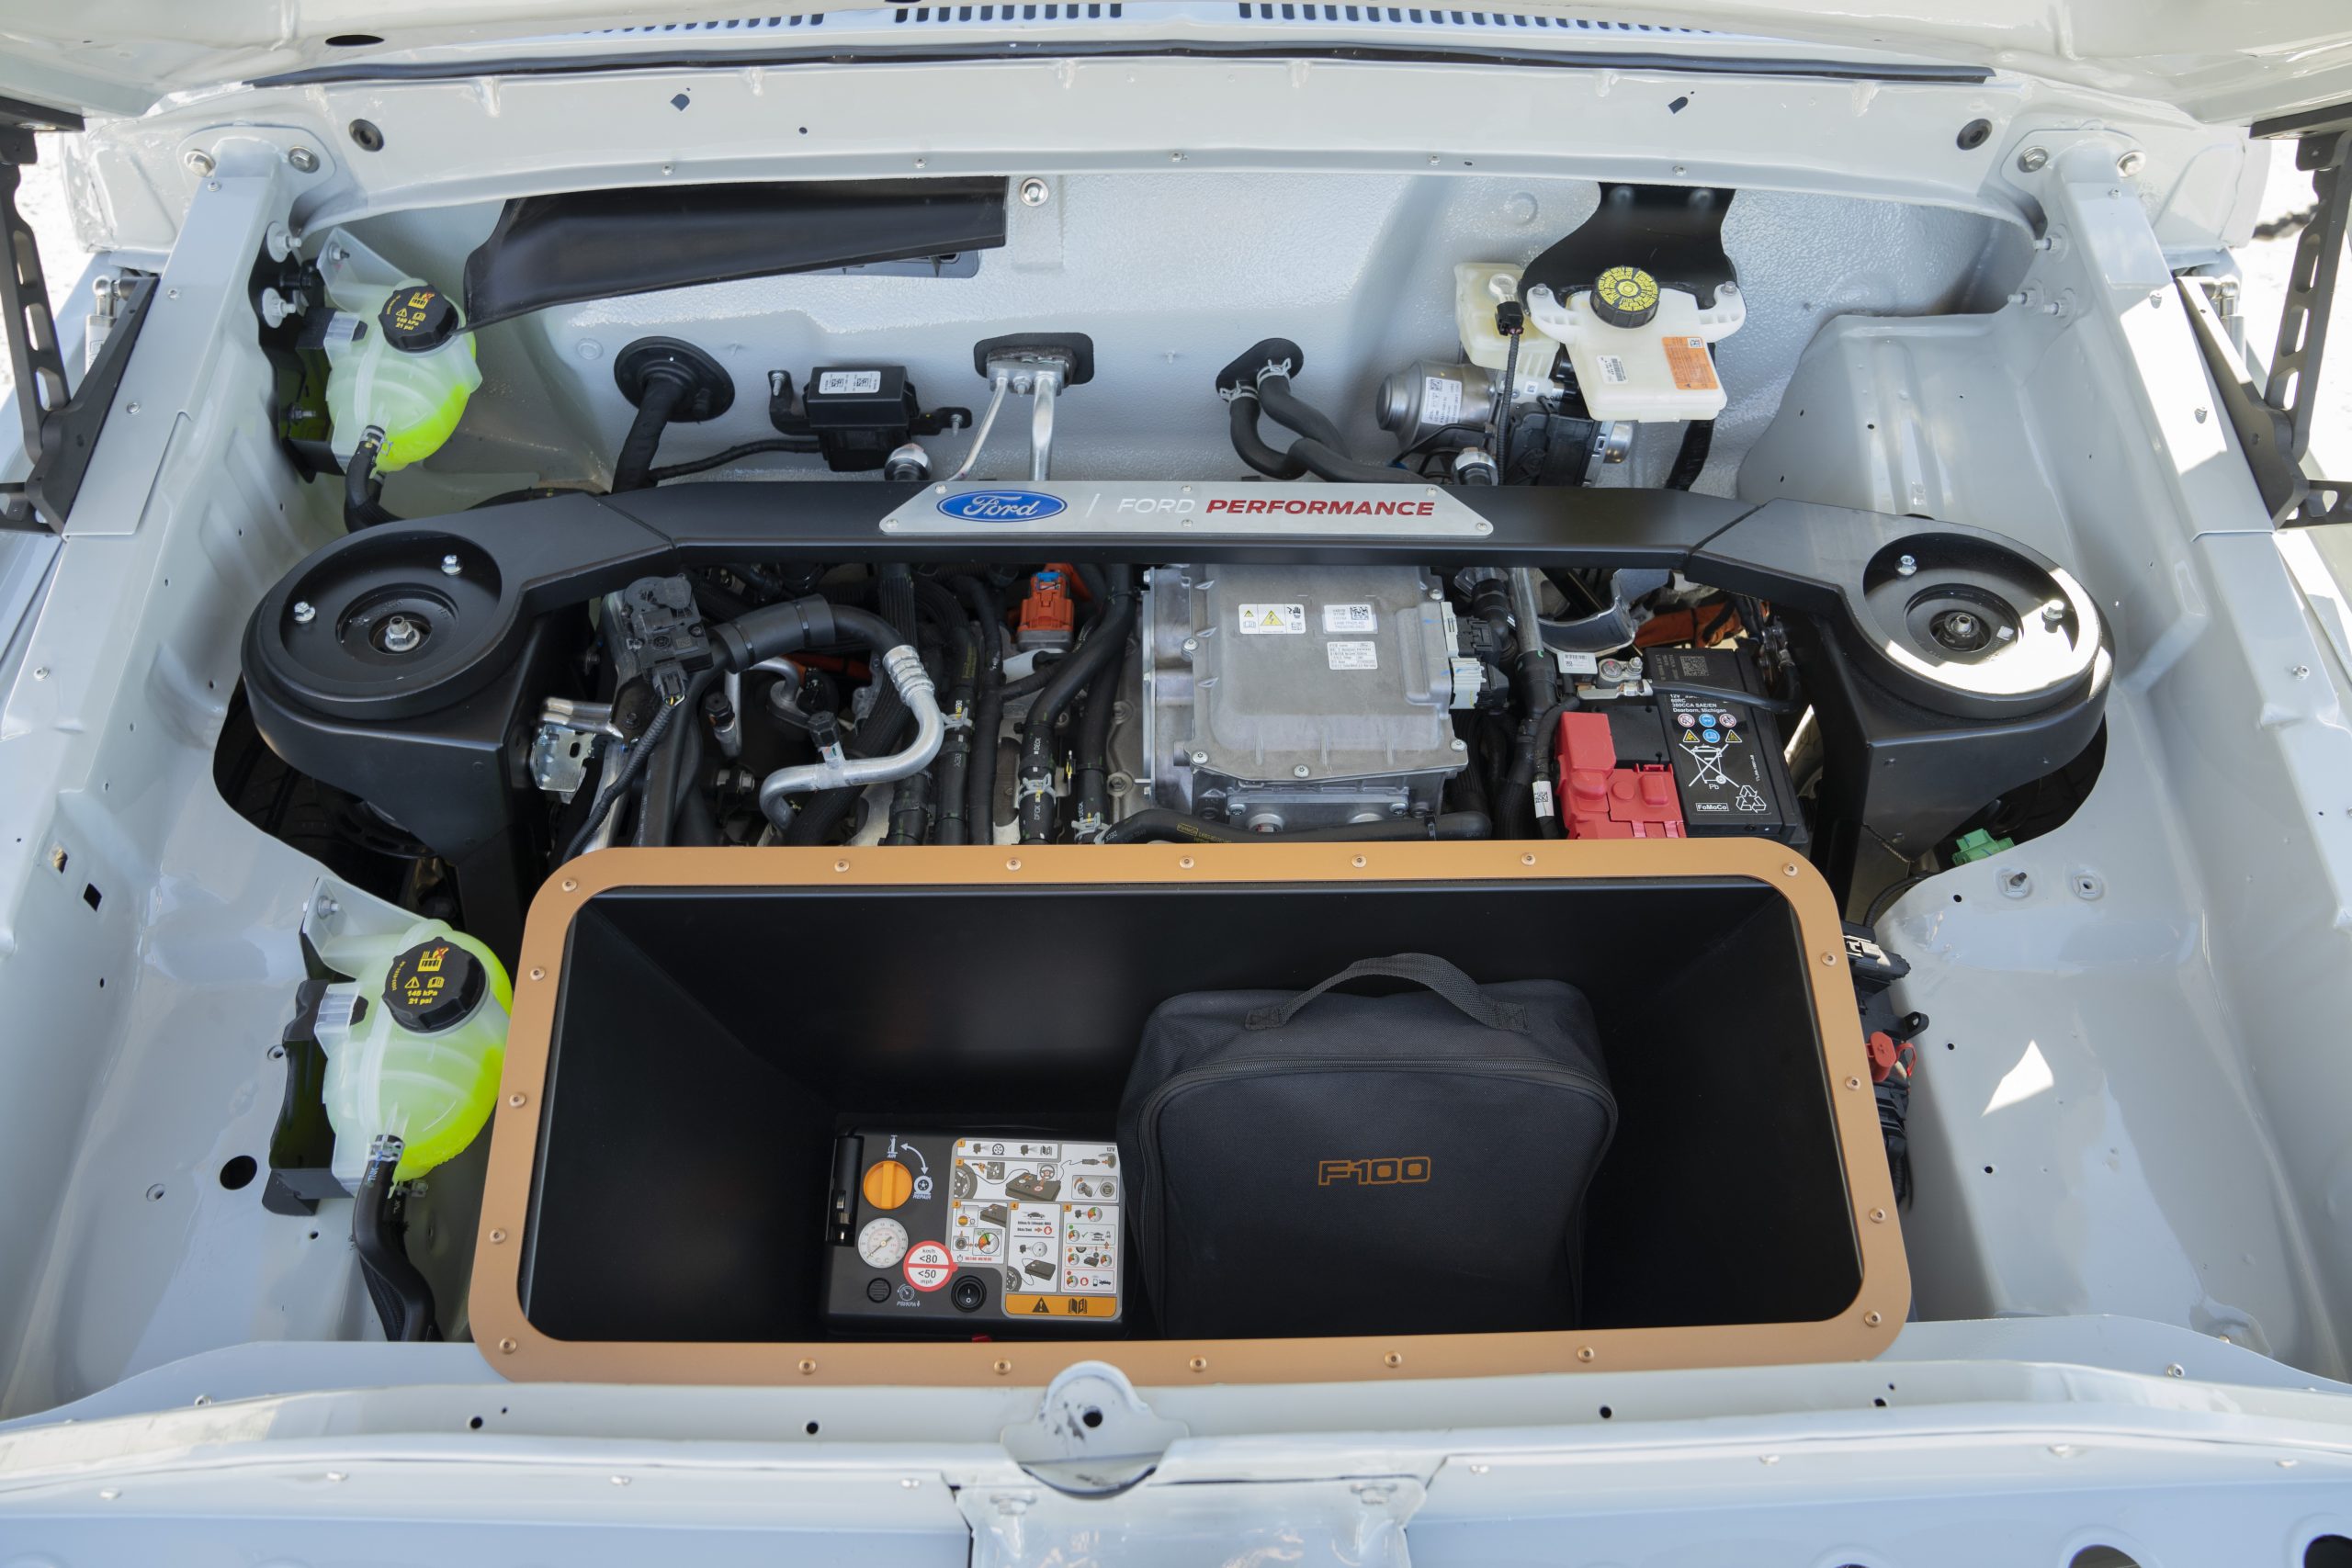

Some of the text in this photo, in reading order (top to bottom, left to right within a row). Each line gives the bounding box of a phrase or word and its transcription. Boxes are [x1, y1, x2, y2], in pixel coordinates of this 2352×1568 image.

[963, 494, 1040, 516] Ford
[1116, 498, 1435, 516] FORD PERFORMANCE
[419, 998, 433, 1006] psi
[1317, 1156, 1431, 1186] F100
[919, 1254, 938, 1264] <80
[918, 1269, 936, 1279] <50
